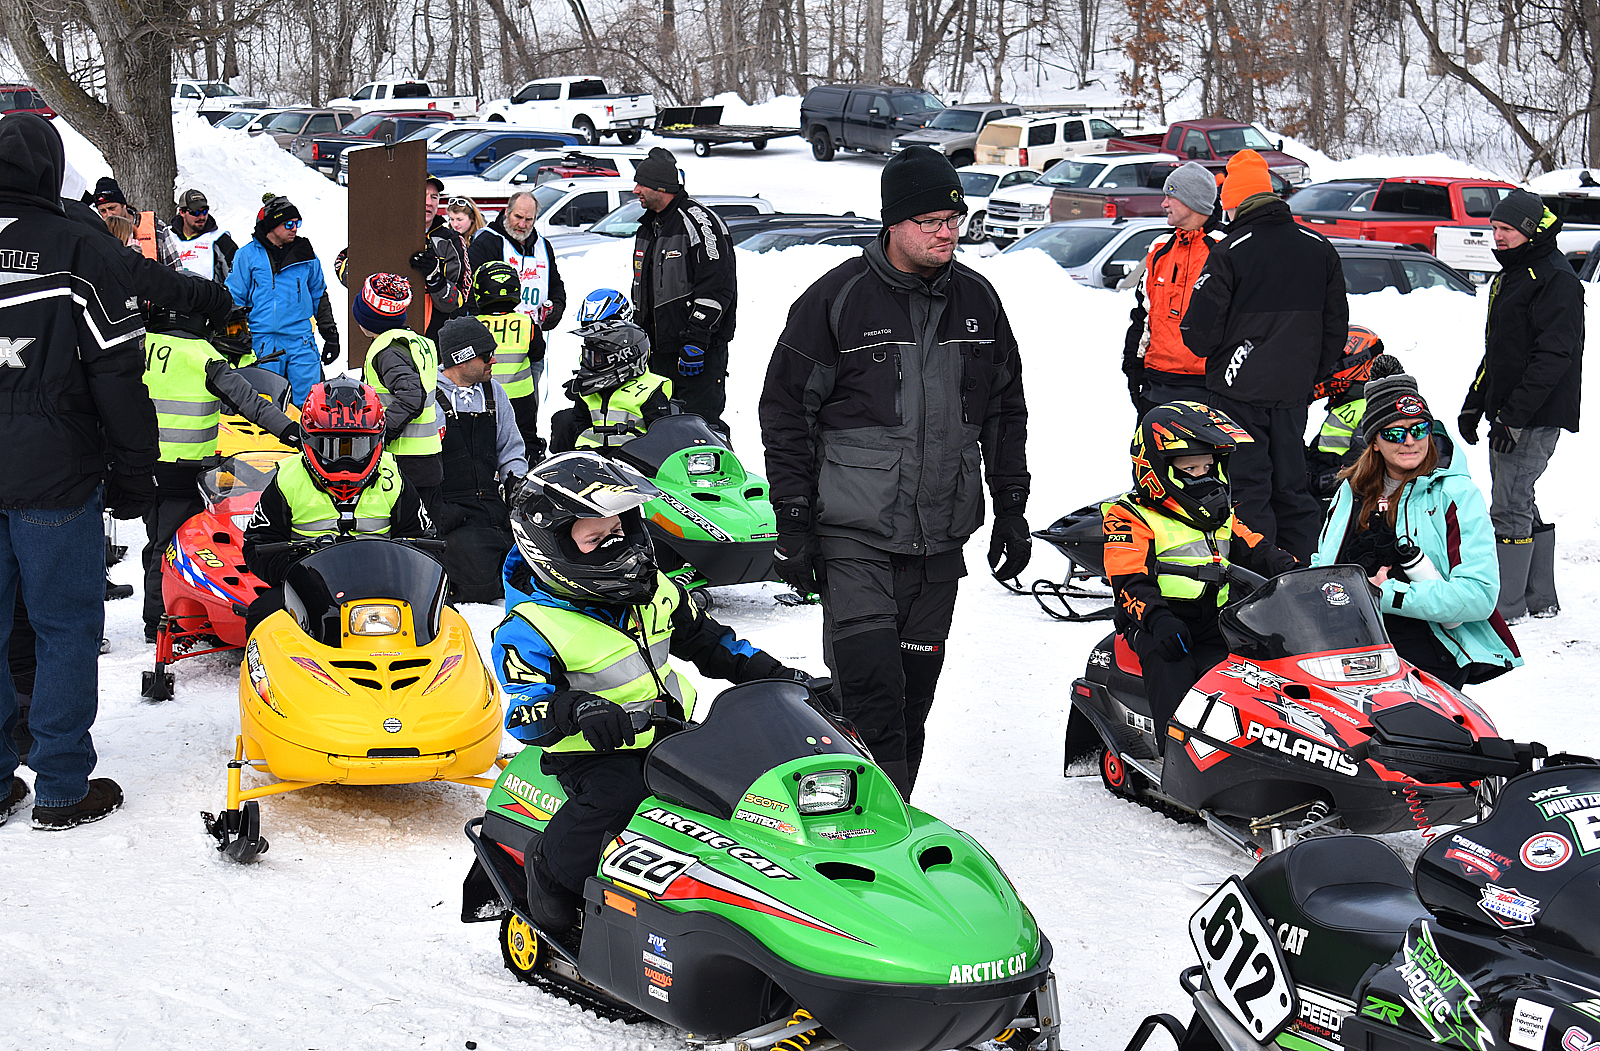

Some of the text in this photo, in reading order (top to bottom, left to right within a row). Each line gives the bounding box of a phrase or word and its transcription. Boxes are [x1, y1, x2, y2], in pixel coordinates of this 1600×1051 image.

[1463, 238, 1489, 246] GMC
[521, 286, 540, 305] 40
[863, 328, 892, 337] PREDATOR
[146, 342, 172, 374] 19
[606, 346, 633, 363] FXR
[1224, 345, 1249, 387] FXR
[620, 379, 649, 398] 24
[1330, 380, 1350, 388] 215
[1338, 403, 1356, 424] 20
[659, 489, 728, 541] NOPRO
[1107, 534, 1127, 542] FXR
[195, 548, 225, 568] 120
[900, 641, 934, 652] STRIKER
[576, 699, 611, 713] FXR
[1246, 720, 1360, 778] POLARIS
[503, 772, 563, 814] ARCTIC CAT
[744, 793, 789, 812] SCOTT
[735, 809, 780, 831] SPORTECH
[640, 807, 799, 881] ARCTIC CAT
[610, 844, 687, 885] 120
[1494, 892, 1527, 908] AMSOIL
[1484, 901, 1528, 921] SNOCROSS
[647, 932, 668, 947] FOX
[1276, 922, 1310, 956] CAT
[949, 952, 1027, 984] ARCTIC CAT
[1203, 892, 1276, 1025] 612
[1412, 936, 1460, 993] TEAM
[1394, 959, 1452, 1024] ARCTIC
[1298, 999, 1344, 1032] PEED
[1361, 995, 1405, 1026] ZR
